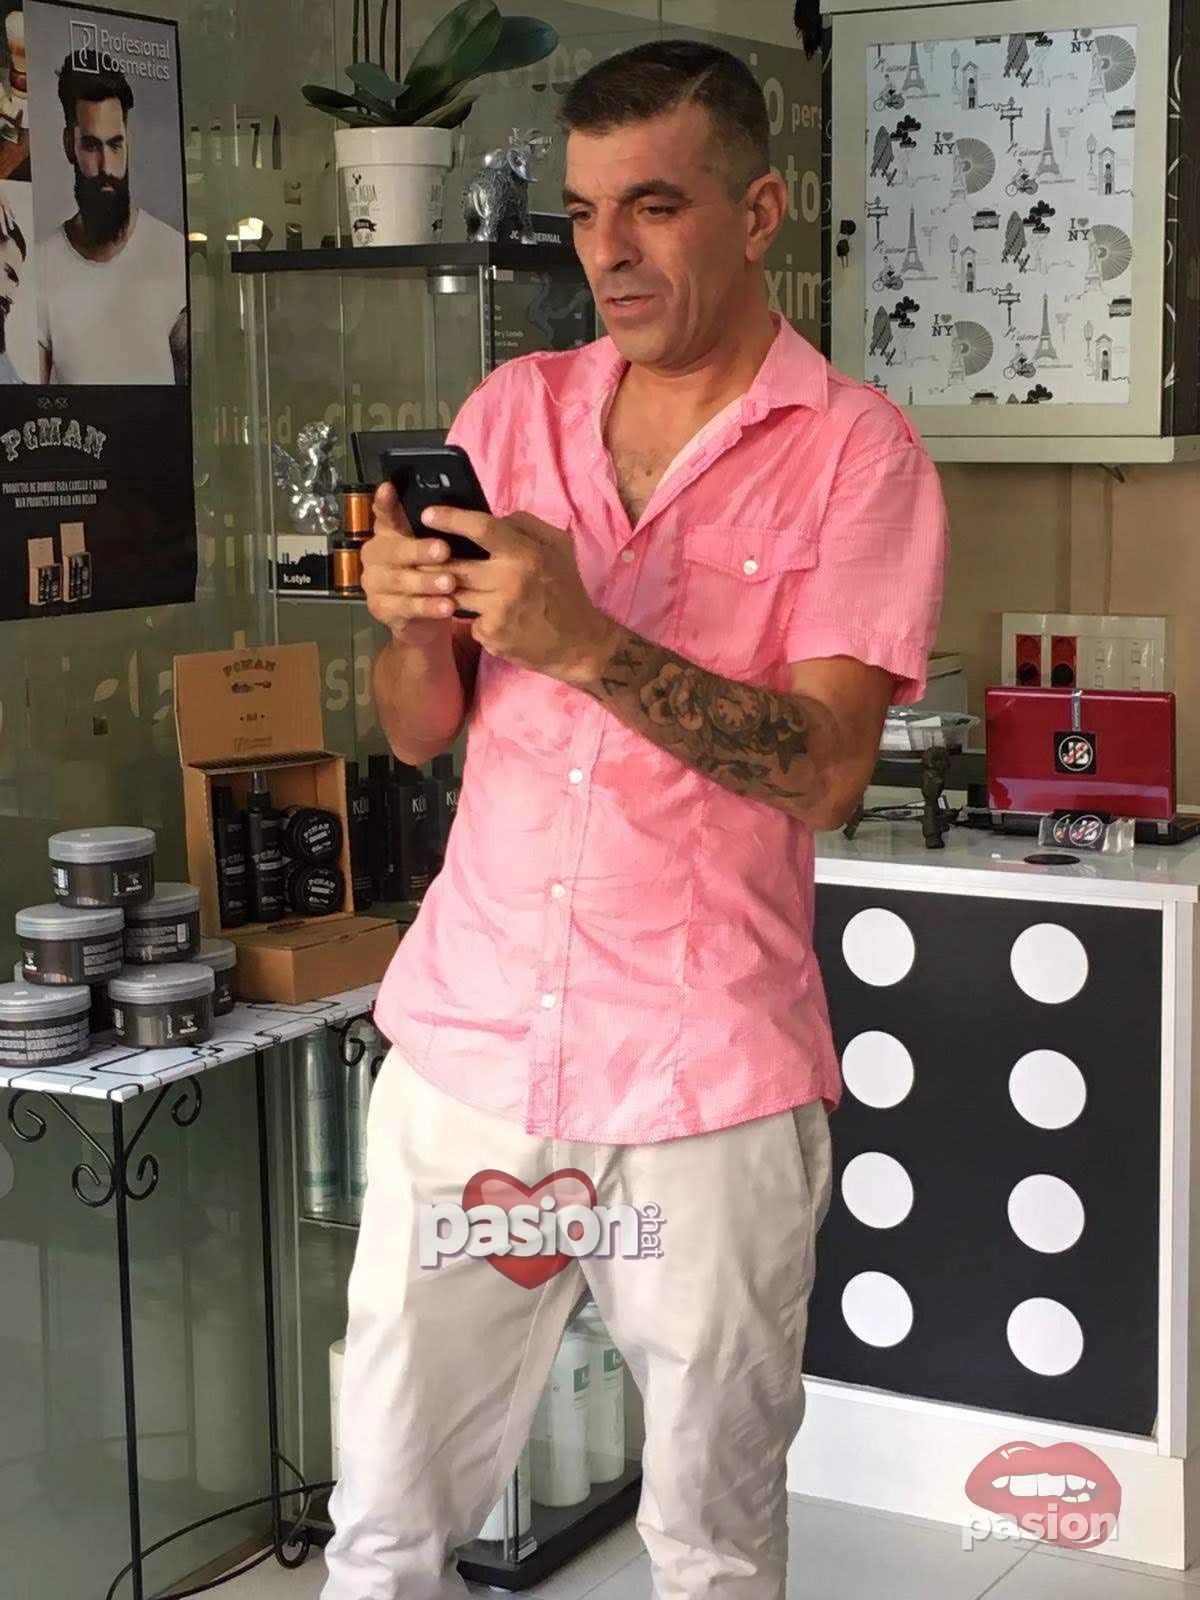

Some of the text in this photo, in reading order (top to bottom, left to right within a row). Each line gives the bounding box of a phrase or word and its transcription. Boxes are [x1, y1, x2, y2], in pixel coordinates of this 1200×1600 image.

[100, 28, 170, 59] Profesional
[1071, 39, 1095, 54] NY
[101, 51, 170, 81] Cosmetics
[933, 143, 955, 156] NY
[1067, 228, 1090, 242] NY
[931, 325, 952, 338] NY
